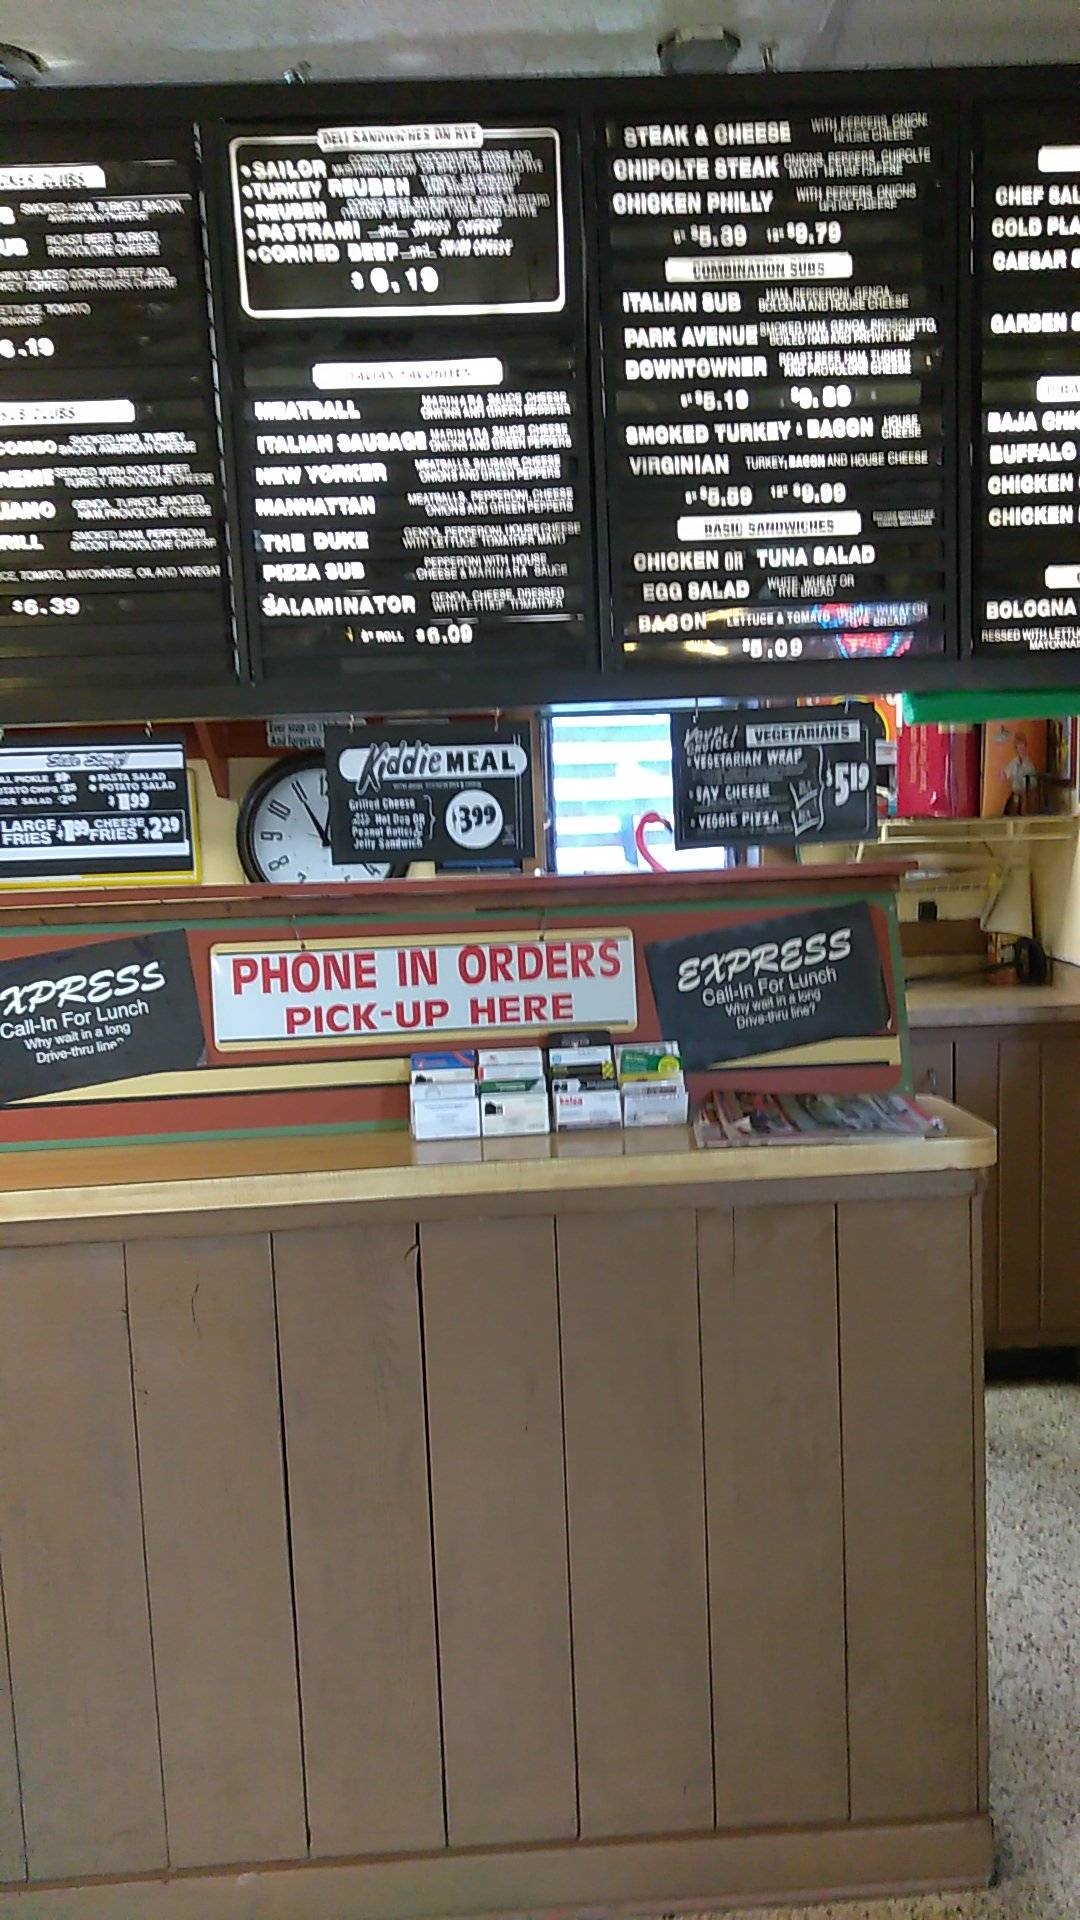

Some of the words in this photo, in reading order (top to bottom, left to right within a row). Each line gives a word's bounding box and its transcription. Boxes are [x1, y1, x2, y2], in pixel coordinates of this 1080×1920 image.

[624, 125, 690, 148] STEAK
[714, 121, 791, 146] CHEESE
[252, 159, 327, 180] SAILOR
[613, 157, 709, 181] CHIPOLTE
[715, 155, 780, 180] STEAK
[250, 180, 322, 200] TURKEY
[995, 184, 1044, 207] CHEF
[613, 191, 701, 215] CHICKEN
[707, 190, 774, 214] PHILLY
[256, 220, 361, 242] PASTRAMI
[992, 216, 1042, 238] COLD
[257, 243, 340, 264] CORNED
[992, 249, 1067, 272] CAESAR
[693, 261, 785, 280] COMBINATION
[790, 261, 825, 277] SUBS
[622, 291, 697, 313] ITALIAN
[701, 291, 742, 313] SUB
[991, 312, 1067, 334] GARDEN
[624, 326, 677, 349] PARK
[682, 324, 759, 347] AVENUE
[625, 356, 768, 380] DOWNTOWNER
[626, 424, 709, 446] SMOKED
[714, 421, 791, 444] TURKEY
[807, 417, 874, 439] BACON
[987, 411, 1038, 433] BAJA
[256, 434, 333, 454] ITALIAN
[337, 431, 427, 452] SAUSAGE
[990, 441, 1077, 465] BUFFALO
[629, 454, 730, 476] VIRGINIAN
[788, 454, 825, 469] BACON
[827, 453, 848, 467] AND
[850, 451, 885, 467] HOUSE
[888, 450, 928, 466] CHEESE
[256, 466, 301, 485] NEW
[304, 463, 387, 484] YORKER
[988, 472, 1073, 495] CHICKEN
[255, 496, 375, 516] MANHATTAN
[988, 505, 1073, 528] CHICKEN
[748, 519, 834, 537] SANDWICHES
[261, 534, 306, 552] THE
[313, 531, 369, 550] DUKE
[633, 550, 719, 572] CHICKEN
[724, 551, 744, 571] OR
[757, 546, 808, 568] TUNA
[813, 545, 875, 566] SALAD
[263, 563, 321, 582] PIZZA
[325, 562, 365, 580] SUB
[643, 582, 683, 602] EGG
[688, 580, 750, 601] SALAD
[262, 595, 416, 616] SALAMINATOR
[986, 597, 1077, 620] BOLOGNA
[638, 612, 707, 633] BACON
[787, 610, 830, 626] TOMATO
[754, 726, 850, 742] VEGETARIANS
[355, 740, 442, 795] Kiddie
[447, 751, 516, 773] MEAL
[694, 750, 762, 770] VEGETARIAN
[767, 748, 802, 765] WRAP
[98, 773, 131, 782] PASTA
[132, 772, 166, 781] SALAD
[99, 783, 140, 792] POTATO
[141, 781, 176, 790] SALAD
[382, 796, 415, 810] Cheese
[1, 819, 57, 833] LARGE
[94, 817, 145, 829] CHEESE
[699, 812, 737, 829] VEGGIE
[742, 810, 779, 827] PIZZA
[2, 832, 52, 845] FRIES
[89, 828, 138, 841] FRIES
[232, 951, 377, 996] PHONE
[398, 947, 439, 987] IN
[458, 939, 622, 984] ORDERS
[678, 928, 852, 993] EXPRESS
[702, 984, 754, 1007] Call-In
[758, 977, 784, 996] For
[789, 967, 837, 989] Lunch
[285, 1000, 449, 1035] PICK-UP
[470, 993, 574, 1025] HERE
[725, 1002, 750, 1018] Why
[752, 998, 774, 1012] wait
[776, 996, 787, 1008] in
[789, 996, 797, 1006] a
[798, 989, 821, 1005] long
[0, 1016, 58, 1039] Call-In
[61, 1010, 92, 1029] For
[95, 999, 150, 1023] Lunch
[736, 1010, 790, 1030] Drive-thru
[24, 1036, 52, 1051] Why
[55, 1031, 80, 1045] wait
[81, 1029, 93, 1041] in
[95, 1027, 103, 1038] a
[105, 1023, 131, 1037] long
[36, 1045, 94, 1065] Drive-thru
